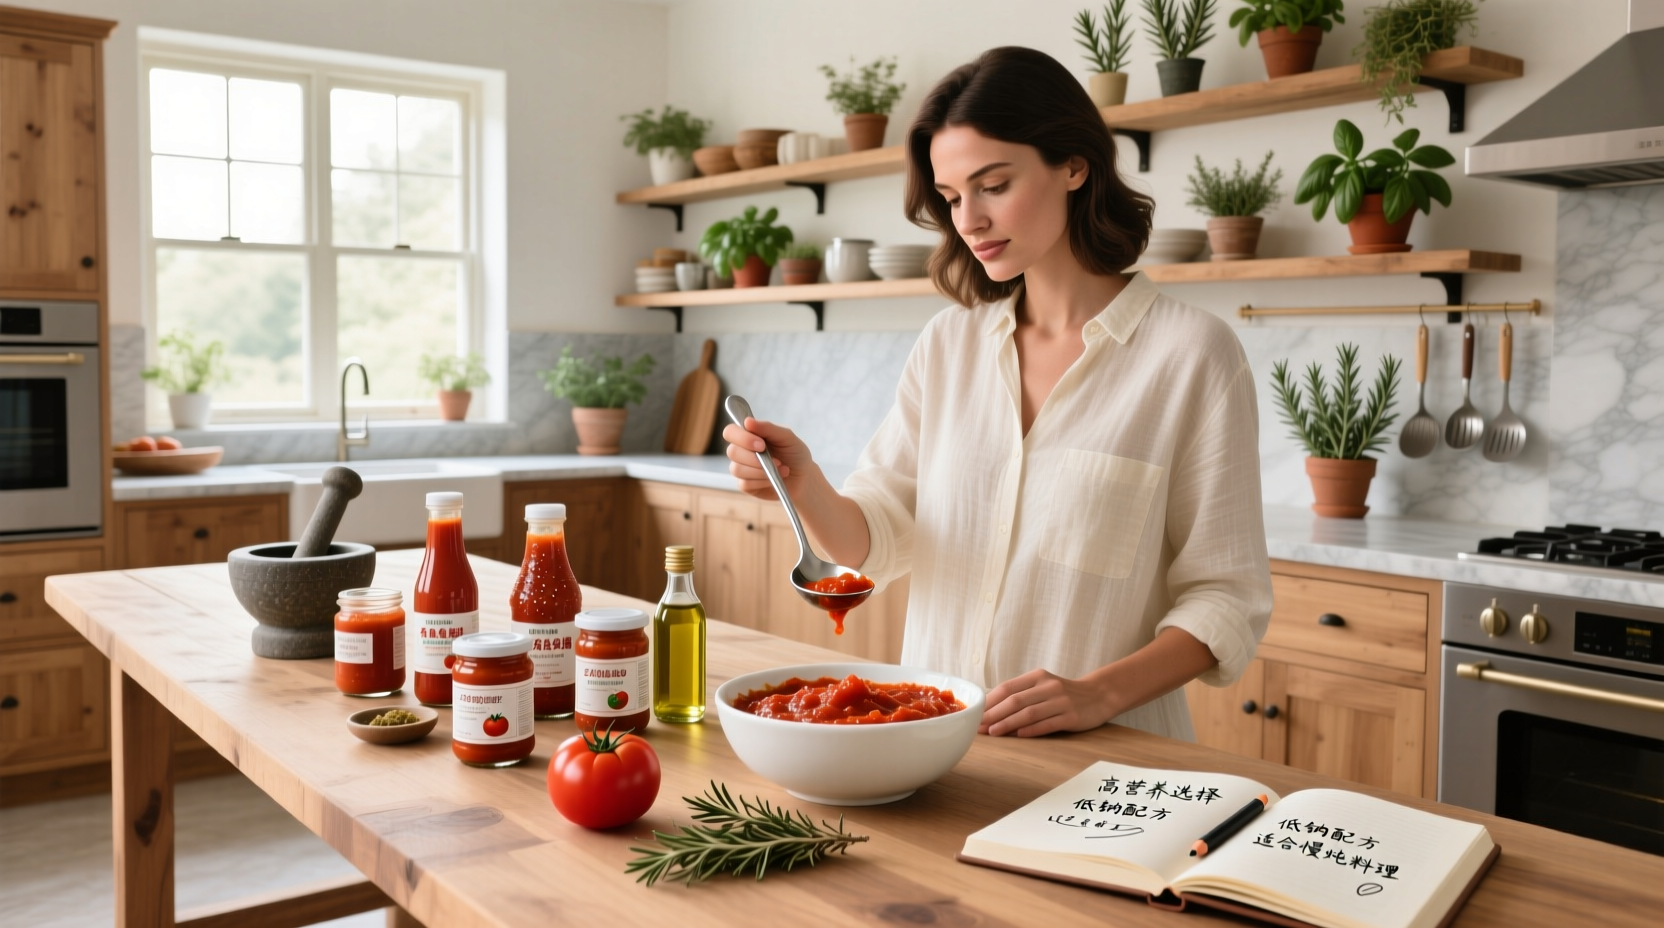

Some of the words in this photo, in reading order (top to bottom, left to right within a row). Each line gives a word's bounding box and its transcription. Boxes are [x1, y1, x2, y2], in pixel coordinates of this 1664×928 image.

[1098, 775, 1223, 805] 高营养选择
[1252, 832, 1399, 880] 适合慢炖料理
